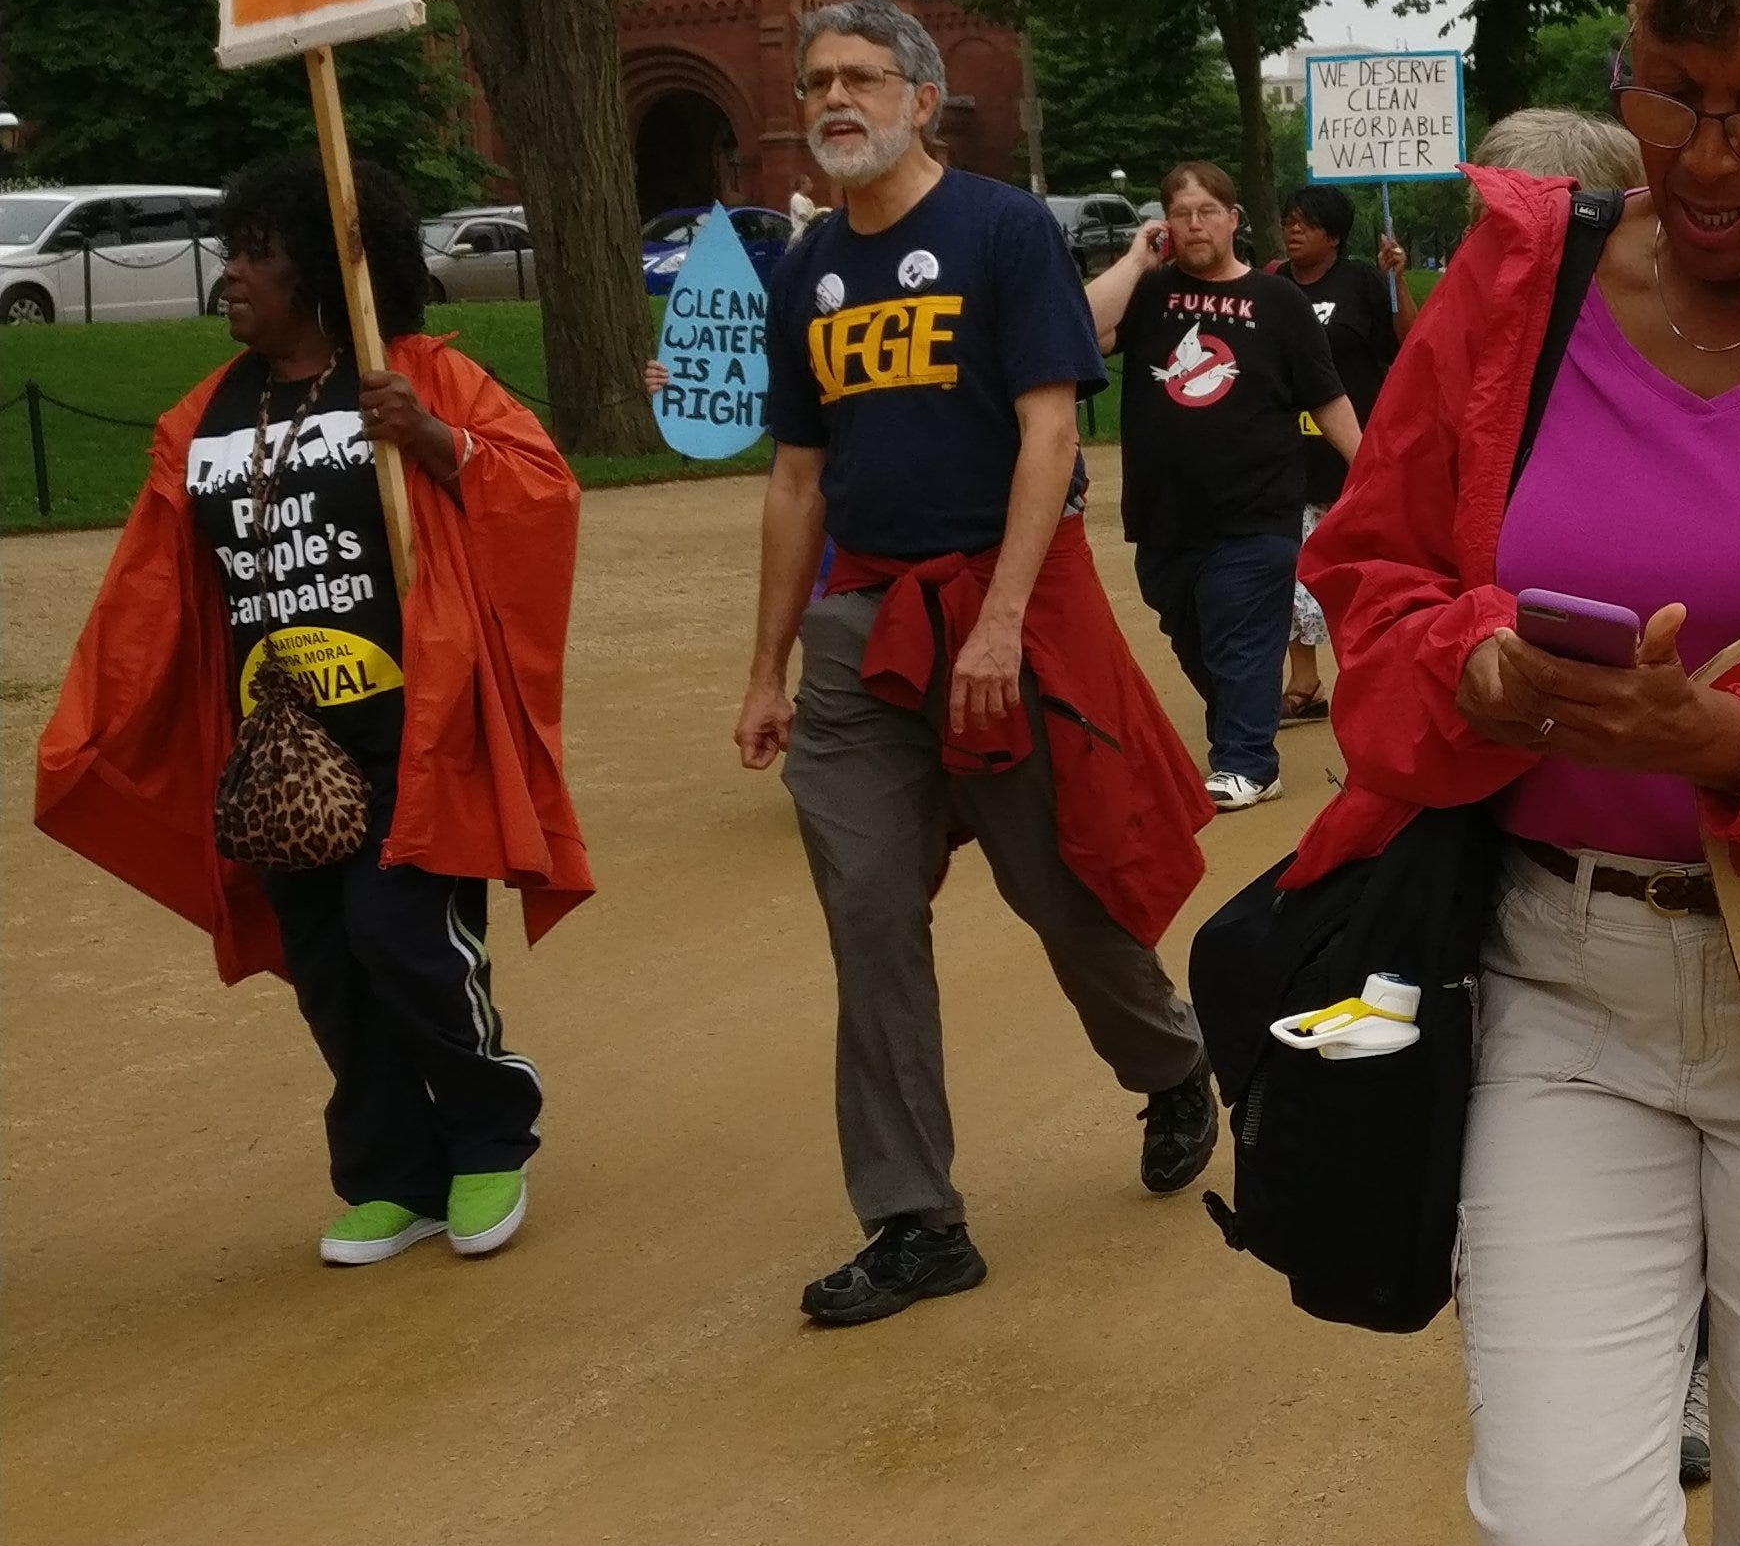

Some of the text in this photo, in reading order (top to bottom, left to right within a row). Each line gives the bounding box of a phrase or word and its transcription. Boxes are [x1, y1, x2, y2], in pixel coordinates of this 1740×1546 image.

[1318, 59, 1448, 88] WE DESERVE
[1347, 86, 1419, 112] CLEAN
[1318, 115, 1454, 141] AFFORDABLE
[1329, 139, 1433, 169] WATER
[672, 287, 767, 321] CLEAN
[1167, 293, 1254, 320] FUKKK
[664, 324, 767, 354] WATER
[672, 356, 746, 385] IS A
[661, 384, 769, 428] RIGHT
[271, 630, 329, 654] NATIONAL
[305, 643, 354, 665] MORAL
